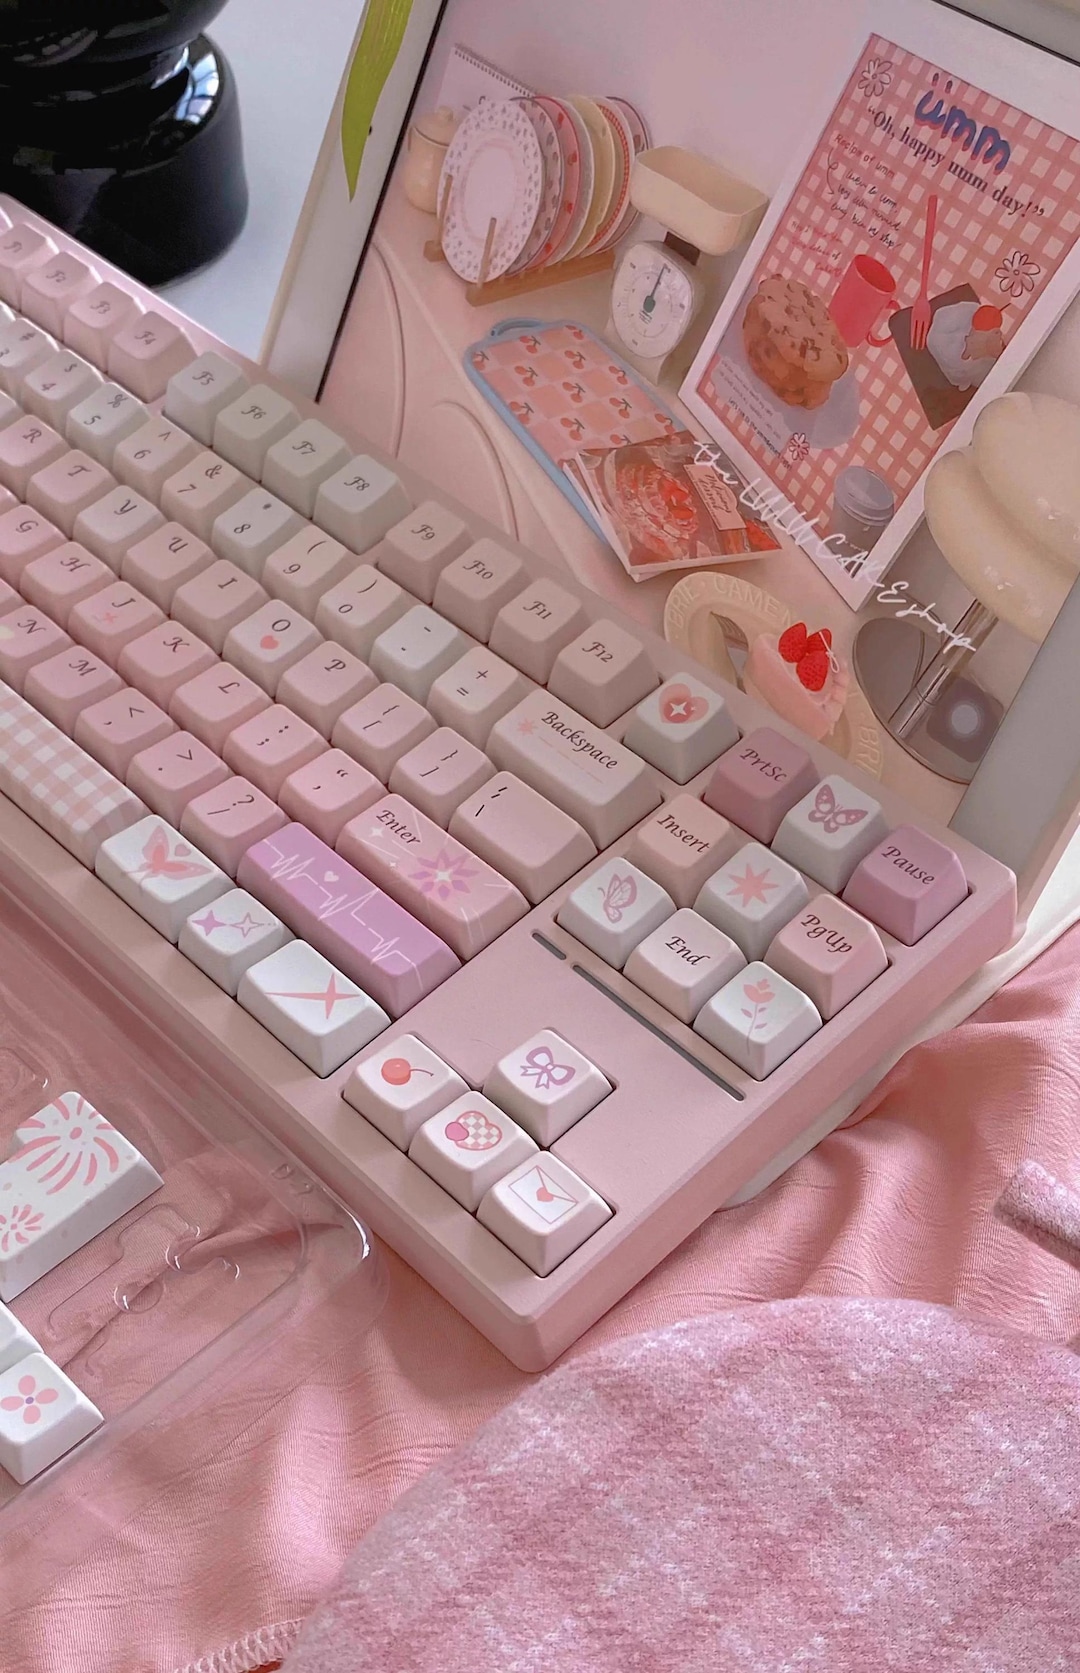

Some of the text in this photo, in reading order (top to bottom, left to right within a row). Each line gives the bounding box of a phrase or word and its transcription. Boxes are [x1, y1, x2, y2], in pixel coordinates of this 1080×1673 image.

[900, 126, 946, 167] happy
[134, 331, 156, 345] F4
[193, 371, 214, 386] F5
[83, 415, 101, 425] 5
[241, 405, 266, 420] F6
[22, 428, 42, 444] R
[133, 450, 151, 460] 6
[292, 440, 316, 455] F7
[67, 465, 92, 477] T
[693, 441, 738, 485] the
[205, 464, 222, 479] &
[177, 484, 196, 494] 7
[344, 476, 370, 491] F8
[113, 499, 138, 515] Y
[15, 520, 39, 533] G
[233, 523, 251, 534] 8
[410, 524, 435, 540] F9
[168, 537, 189, 553] U
[60, 557, 91, 572] H
[283, 563, 300, 574] 9
[463, 559, 493, 579] F10
[217, 577, 238, 589] I
[111, 598, 136, 608] J
[522, 600, 552, 619] F11
[17, 619, 47, 635] N
[163, 636, 190, 652] K
[582, 641, 613, 663] F12
[69, 659, 97, 677] M
[324, 658, 347, 672] P
[218, 681, 240, 694] L
[541, 711, 618, 769] Backspace
[740, 748, 787, 783] PrtSc
[376, 809, 421, 845] Enter
[656, 814, 712, 853] Insert
[881, 846, 935, 885] Pause
[801, 913, 853, 954] PgUp
[665, 936, 711, 966] End
